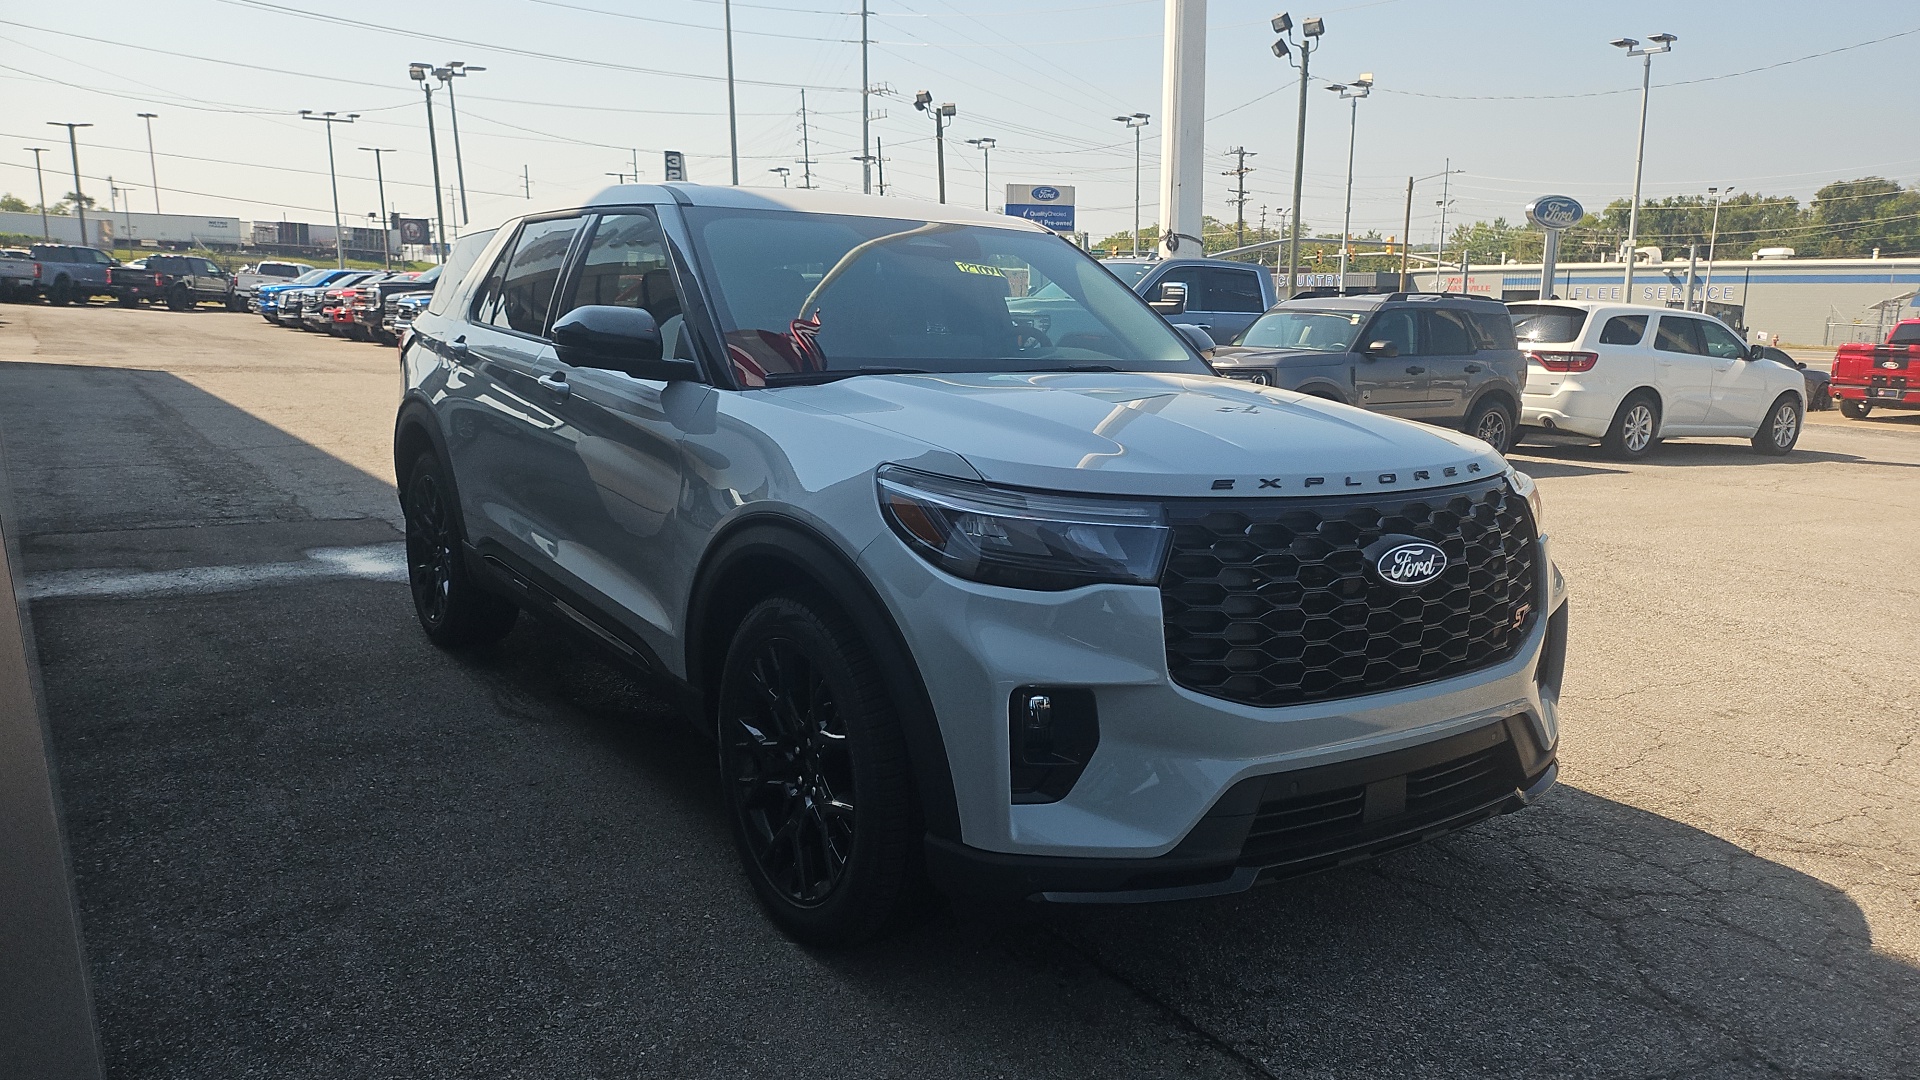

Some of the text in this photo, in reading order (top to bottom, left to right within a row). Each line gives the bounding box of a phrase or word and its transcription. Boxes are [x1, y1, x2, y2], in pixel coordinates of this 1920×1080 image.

[1038, 189, 1056, 199] Ford
[1544, 201, 1576, 222] Ford
[1278, 274, 1342, 288] CUNTRY
[1447, 277, 1475, 285] NOH
[1447, 284, 1491, 292] NASVILLE
[1573, 285, 1735, 301] FLEE SERICE
[1210, 462, 1481, 491] EXPLORER
[1391, 549, 1436, 579] Ford
